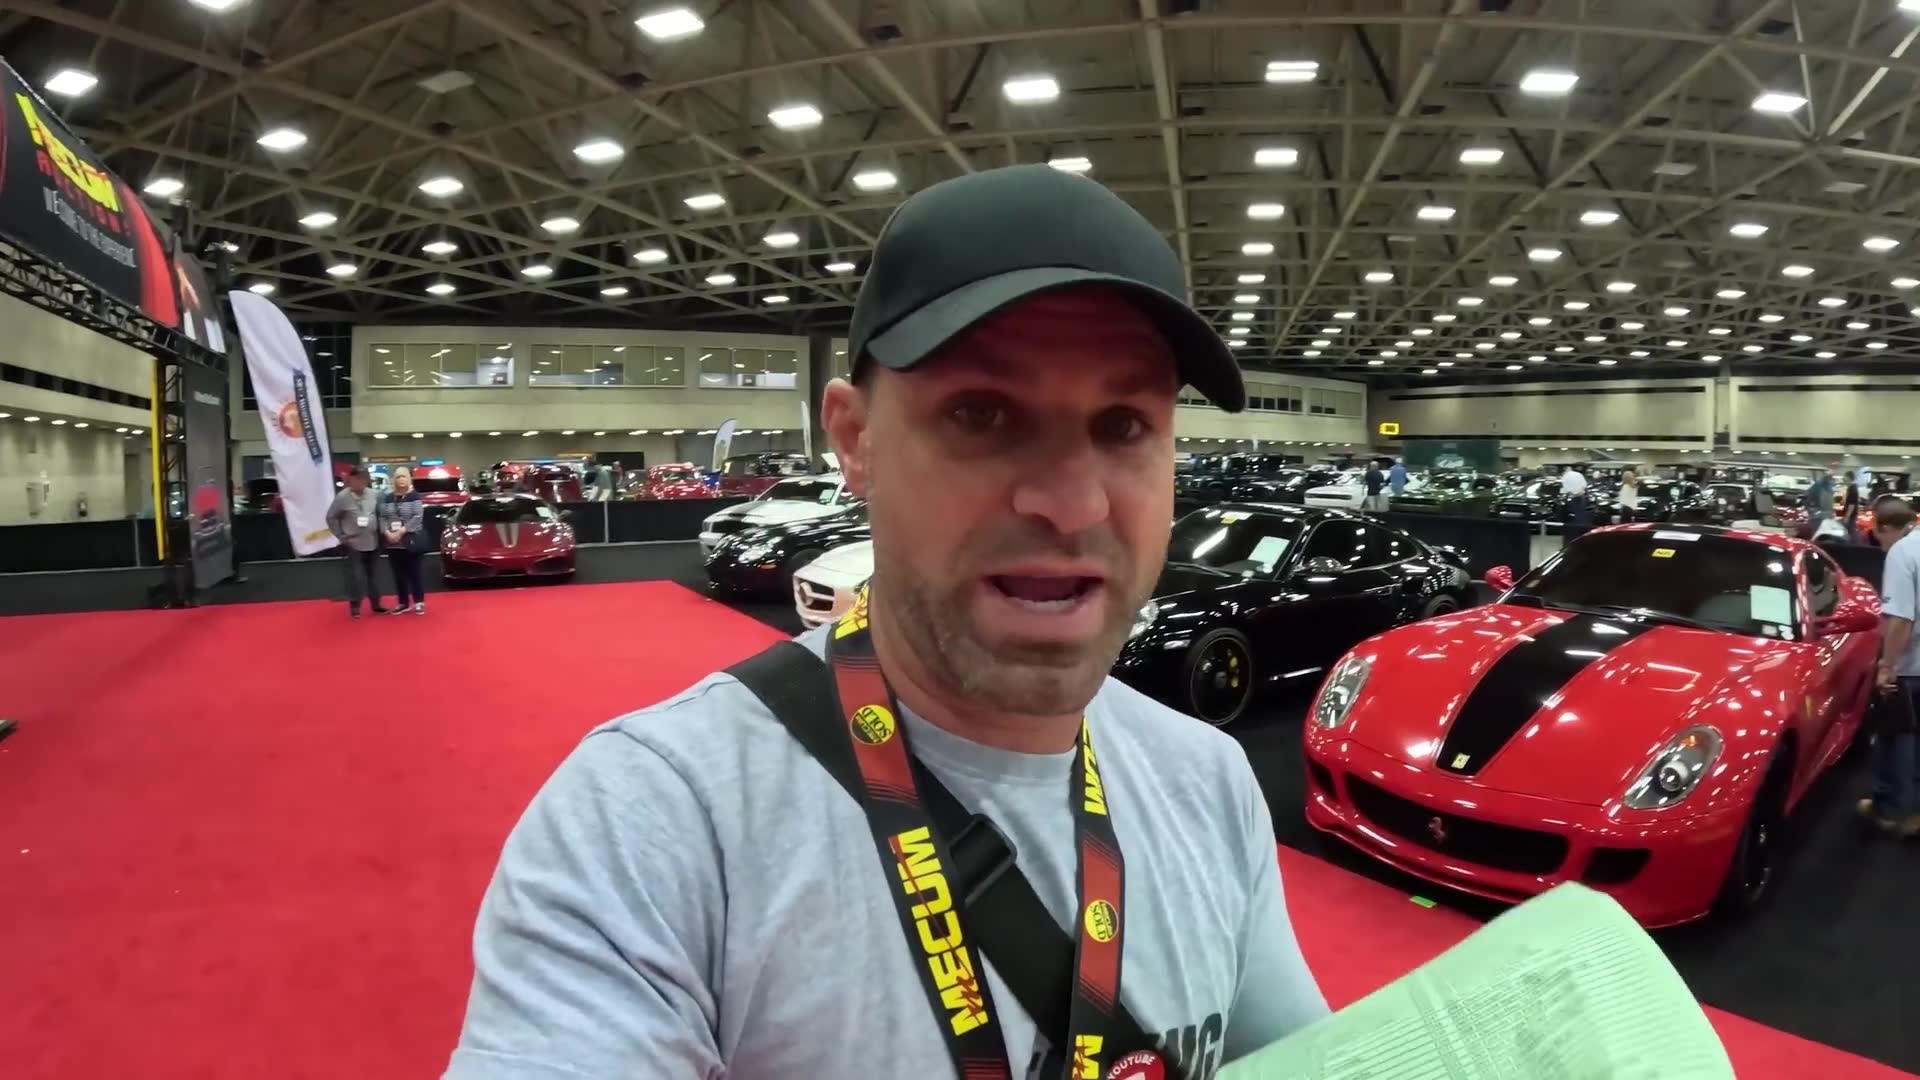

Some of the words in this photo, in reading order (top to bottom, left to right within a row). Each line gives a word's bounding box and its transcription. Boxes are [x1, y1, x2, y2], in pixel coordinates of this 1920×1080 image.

[862, 706, 892, 738] SOLD
[892, 826, 989, 1036] MECUM
[1089, 903, 1106, 940] SOLD
